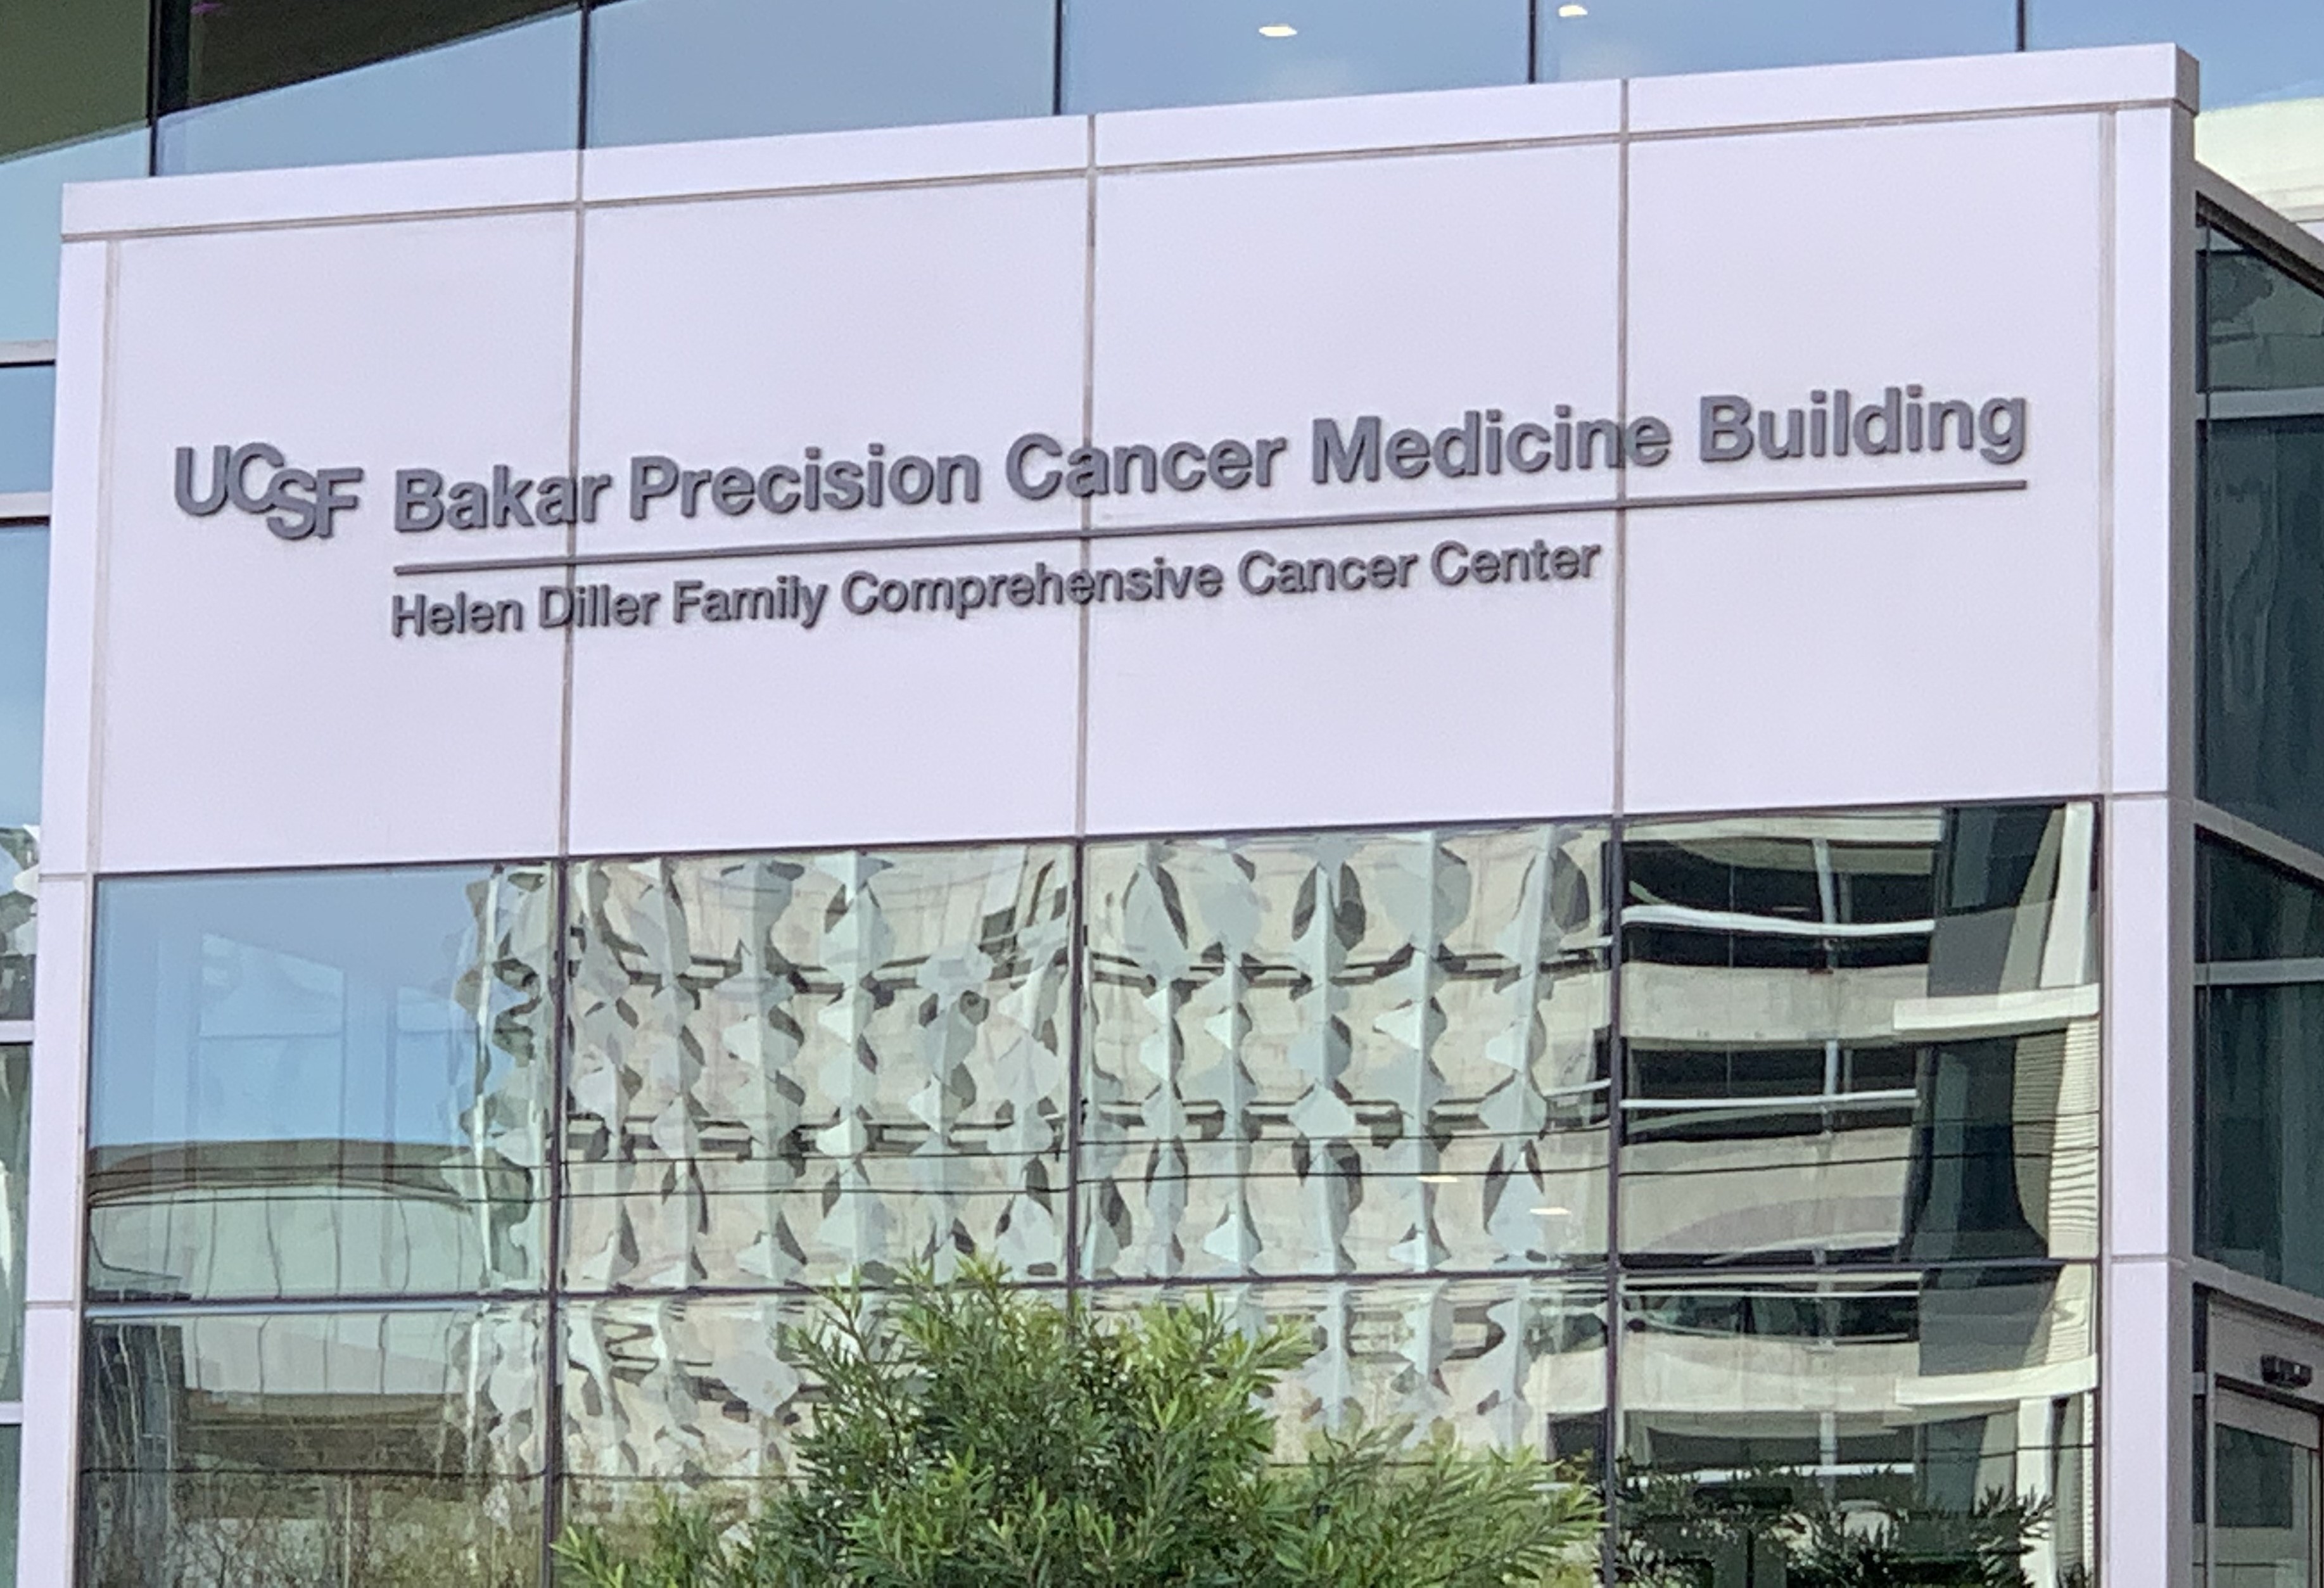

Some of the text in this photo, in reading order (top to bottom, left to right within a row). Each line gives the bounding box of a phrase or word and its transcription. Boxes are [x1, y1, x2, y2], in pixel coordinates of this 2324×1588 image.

[175, 384, 2027, 542] UCSF Bakar Precision Cancer Medicine Building
[392, 539, 1603, 638] Helen Diller Family Comprehensive Cancer Center
